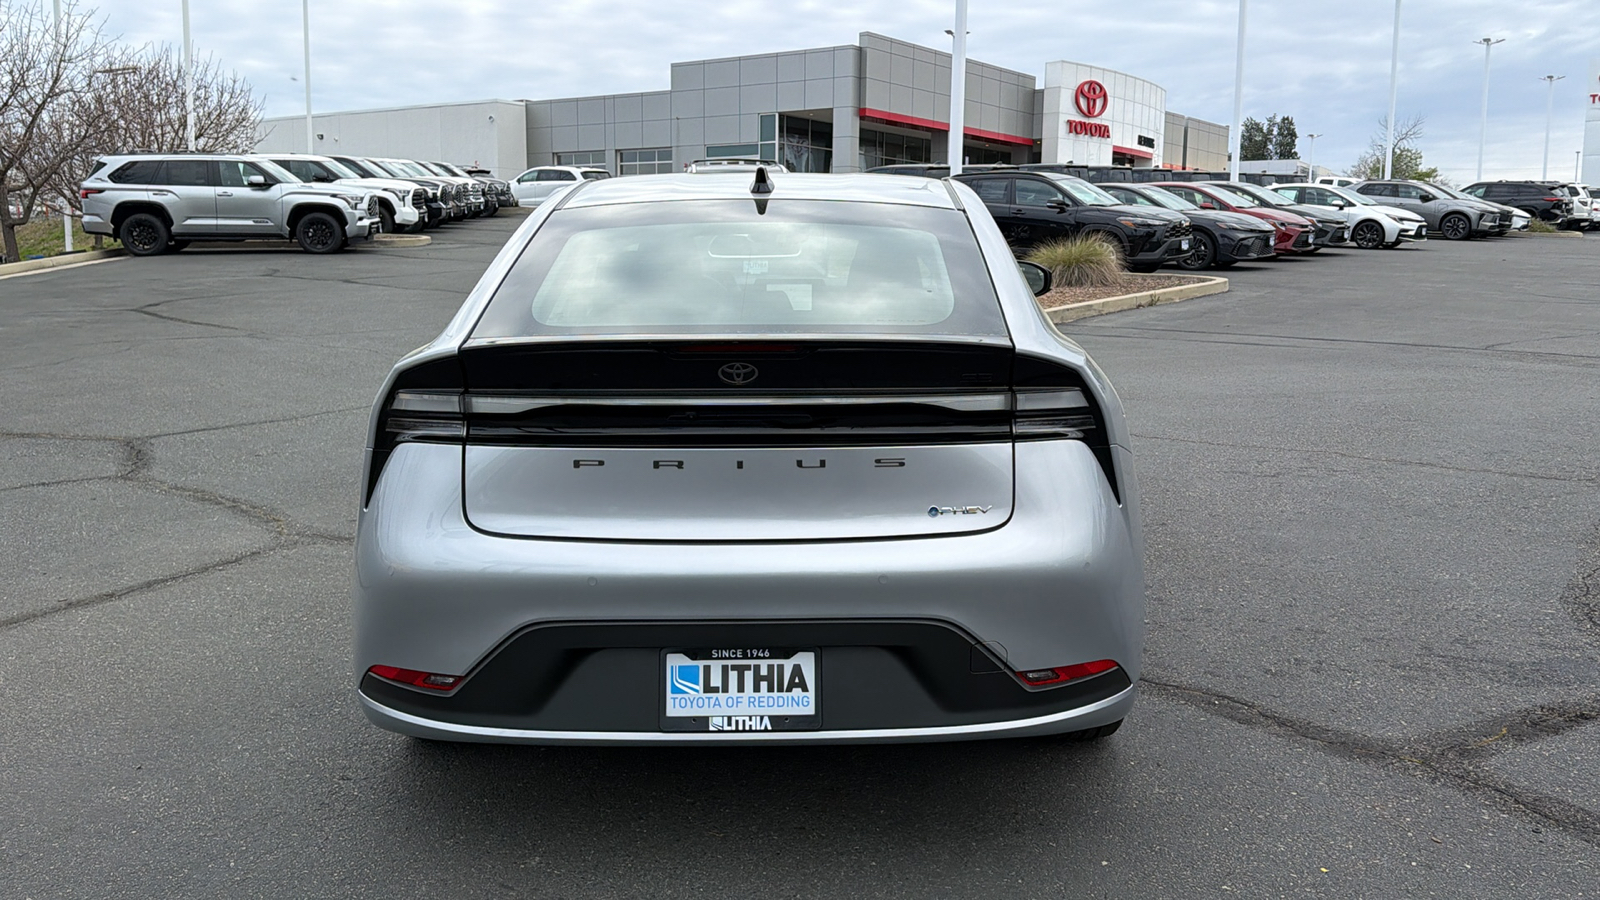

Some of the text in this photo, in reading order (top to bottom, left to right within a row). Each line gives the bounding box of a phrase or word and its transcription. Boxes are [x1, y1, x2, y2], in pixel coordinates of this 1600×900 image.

[1067, 119, 1111, 139] TOYOTA
[573, 458, 906, 469] PRIUS
[711, 649, 770, 658] SINCE 1946
[702, 663, 809, 694] LITHIA
[670, 695, 810, 709] TOYOTA OF REDDING
[723, 716, 772, 730] LITHIA
